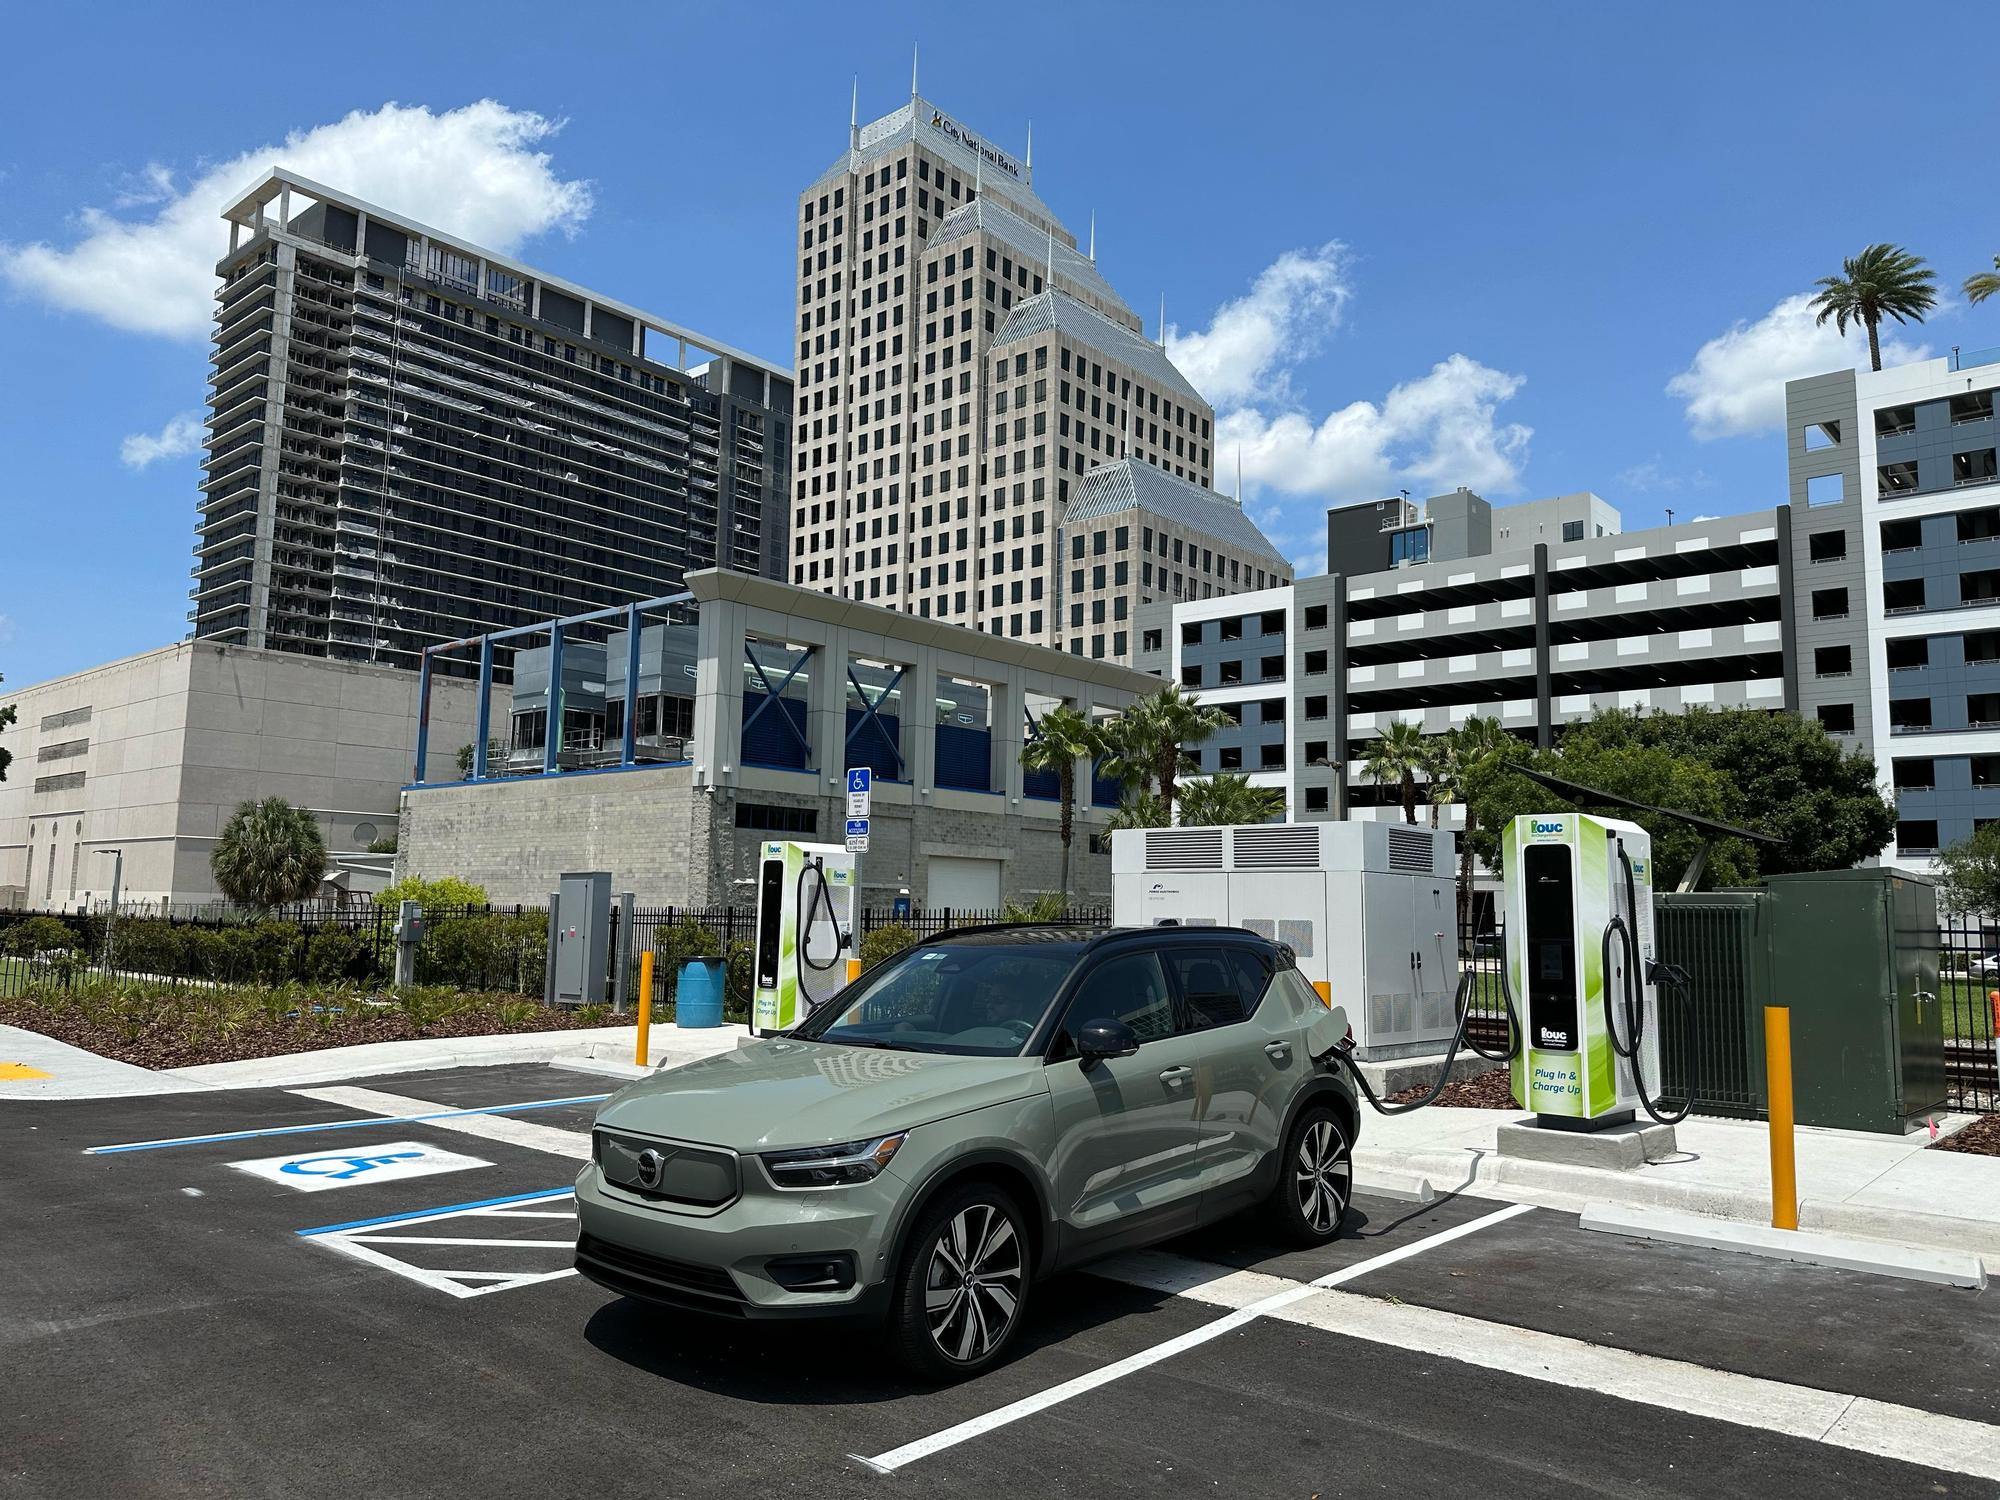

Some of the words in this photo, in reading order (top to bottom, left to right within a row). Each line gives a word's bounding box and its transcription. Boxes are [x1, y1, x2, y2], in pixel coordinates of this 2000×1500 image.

[943, 120, 961, 141] City
[961, 131, 997, 163] National
[998, 154, 1018, 177] Bank
[1535, 1069, 1554, 1080] Plug
[1558, 1071, 1566, 1079] In
[1569, 1072, 1576, 1080] &
[1533, 1082, 1564, 1093] Charge
[1568, 1085, 1580, 1095] Up
